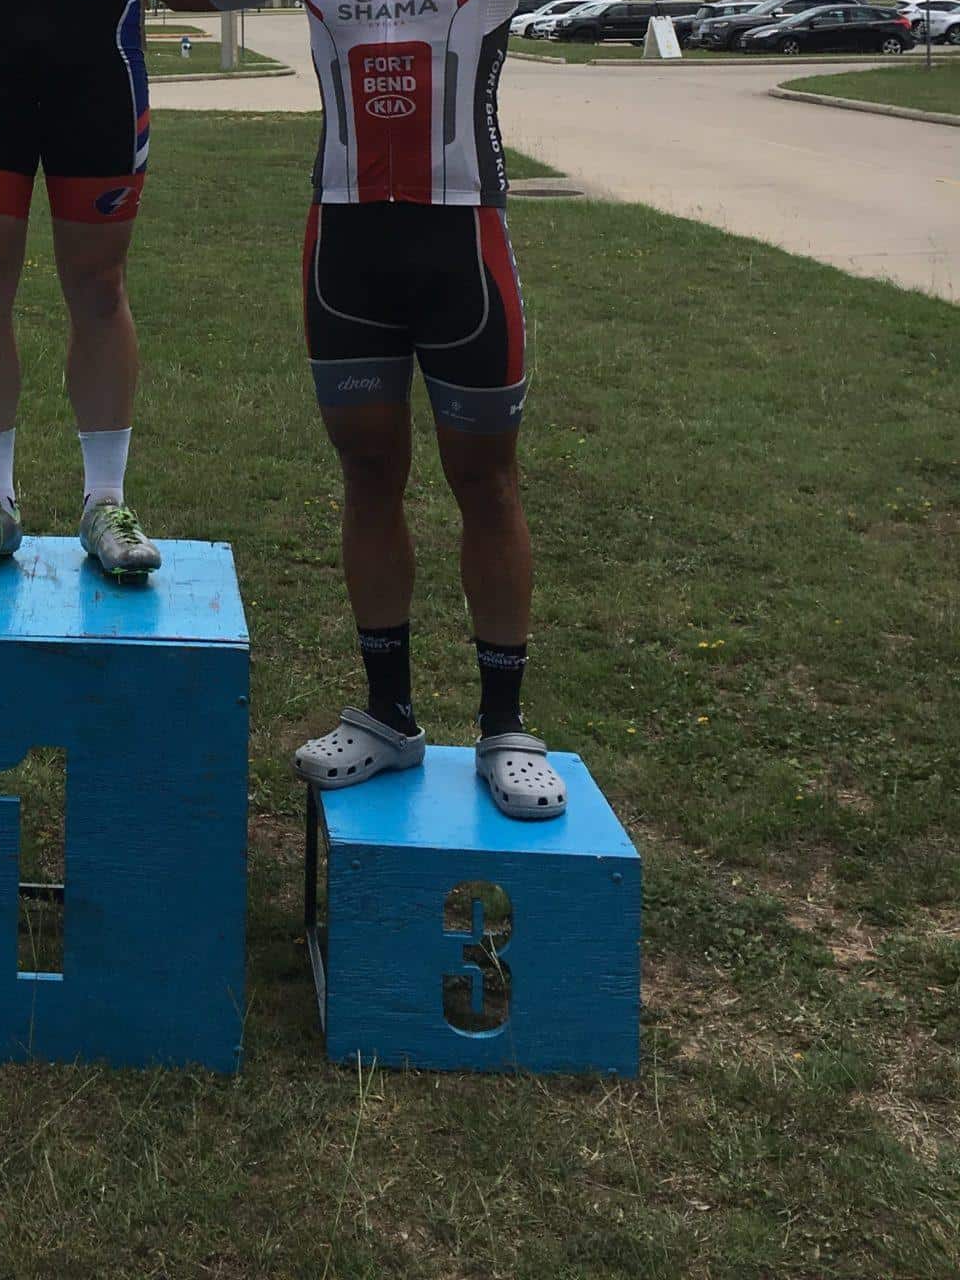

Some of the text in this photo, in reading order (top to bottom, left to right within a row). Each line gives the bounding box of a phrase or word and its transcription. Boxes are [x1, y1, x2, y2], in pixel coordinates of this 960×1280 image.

[363, 55, 415, 73] FORT
[363, 75, 417, 93] BEND
[373, 99, 407, 114] KIA
[485, 48, 507, 192] FORT BEND KIA
[442, 879, 514, 1039] 3
